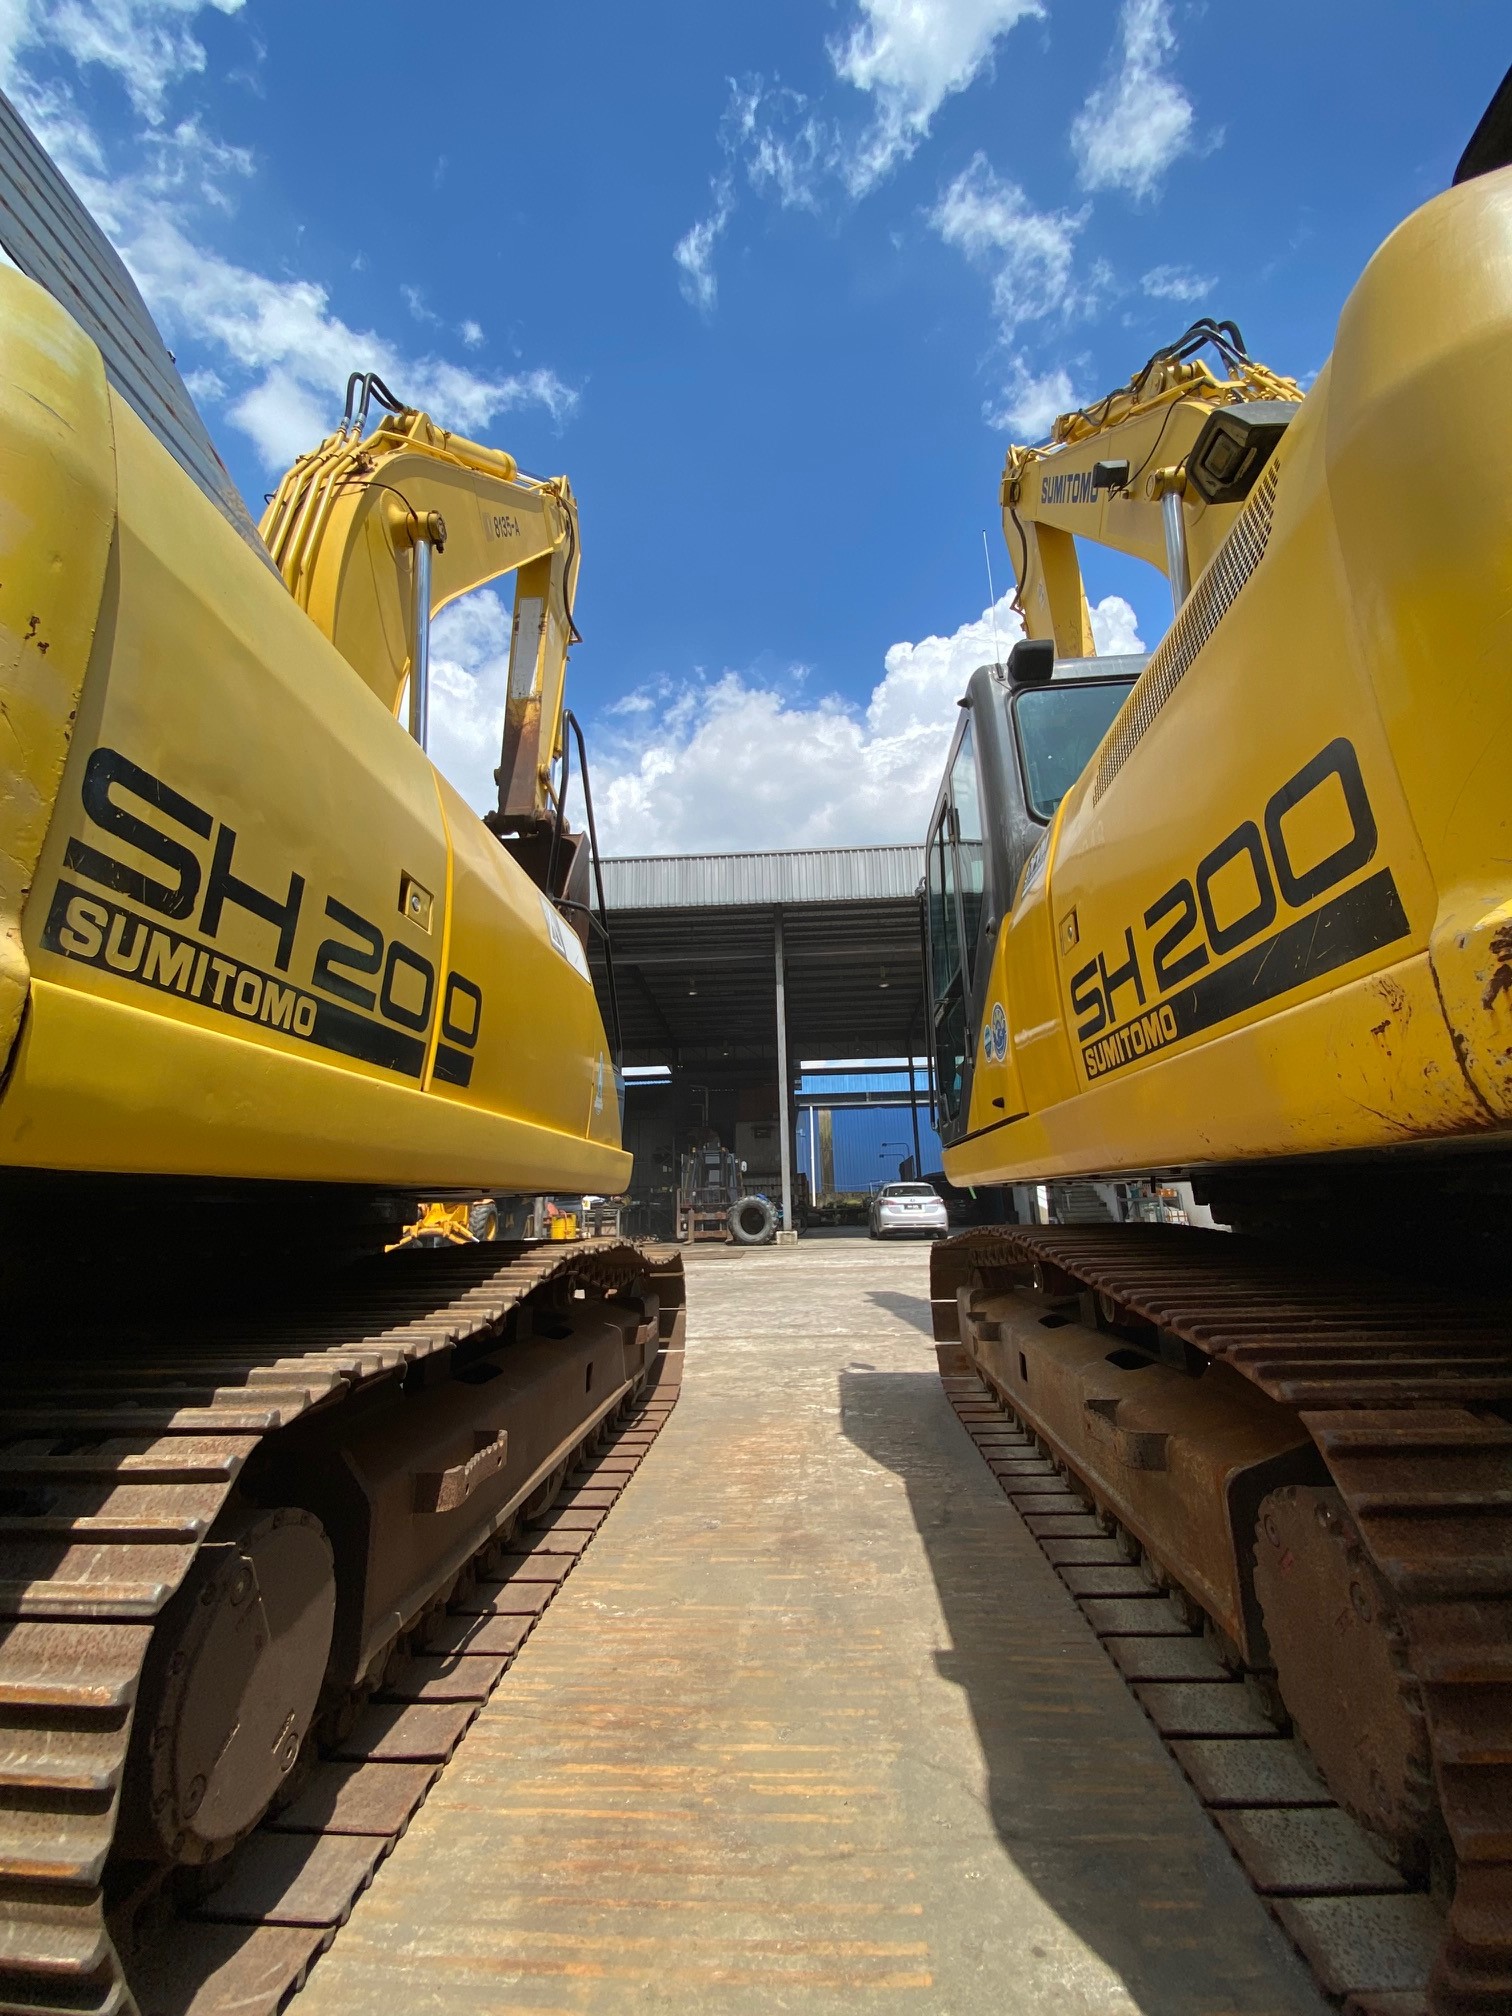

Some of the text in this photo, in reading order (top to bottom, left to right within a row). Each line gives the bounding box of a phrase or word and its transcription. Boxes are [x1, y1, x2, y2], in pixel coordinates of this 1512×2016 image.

[493, 515, 521, 538] 8135-A
[59, 896, 317, 1037] SUMITOMO
[1085, 1004, 1178, 1076] SUMITOMO
